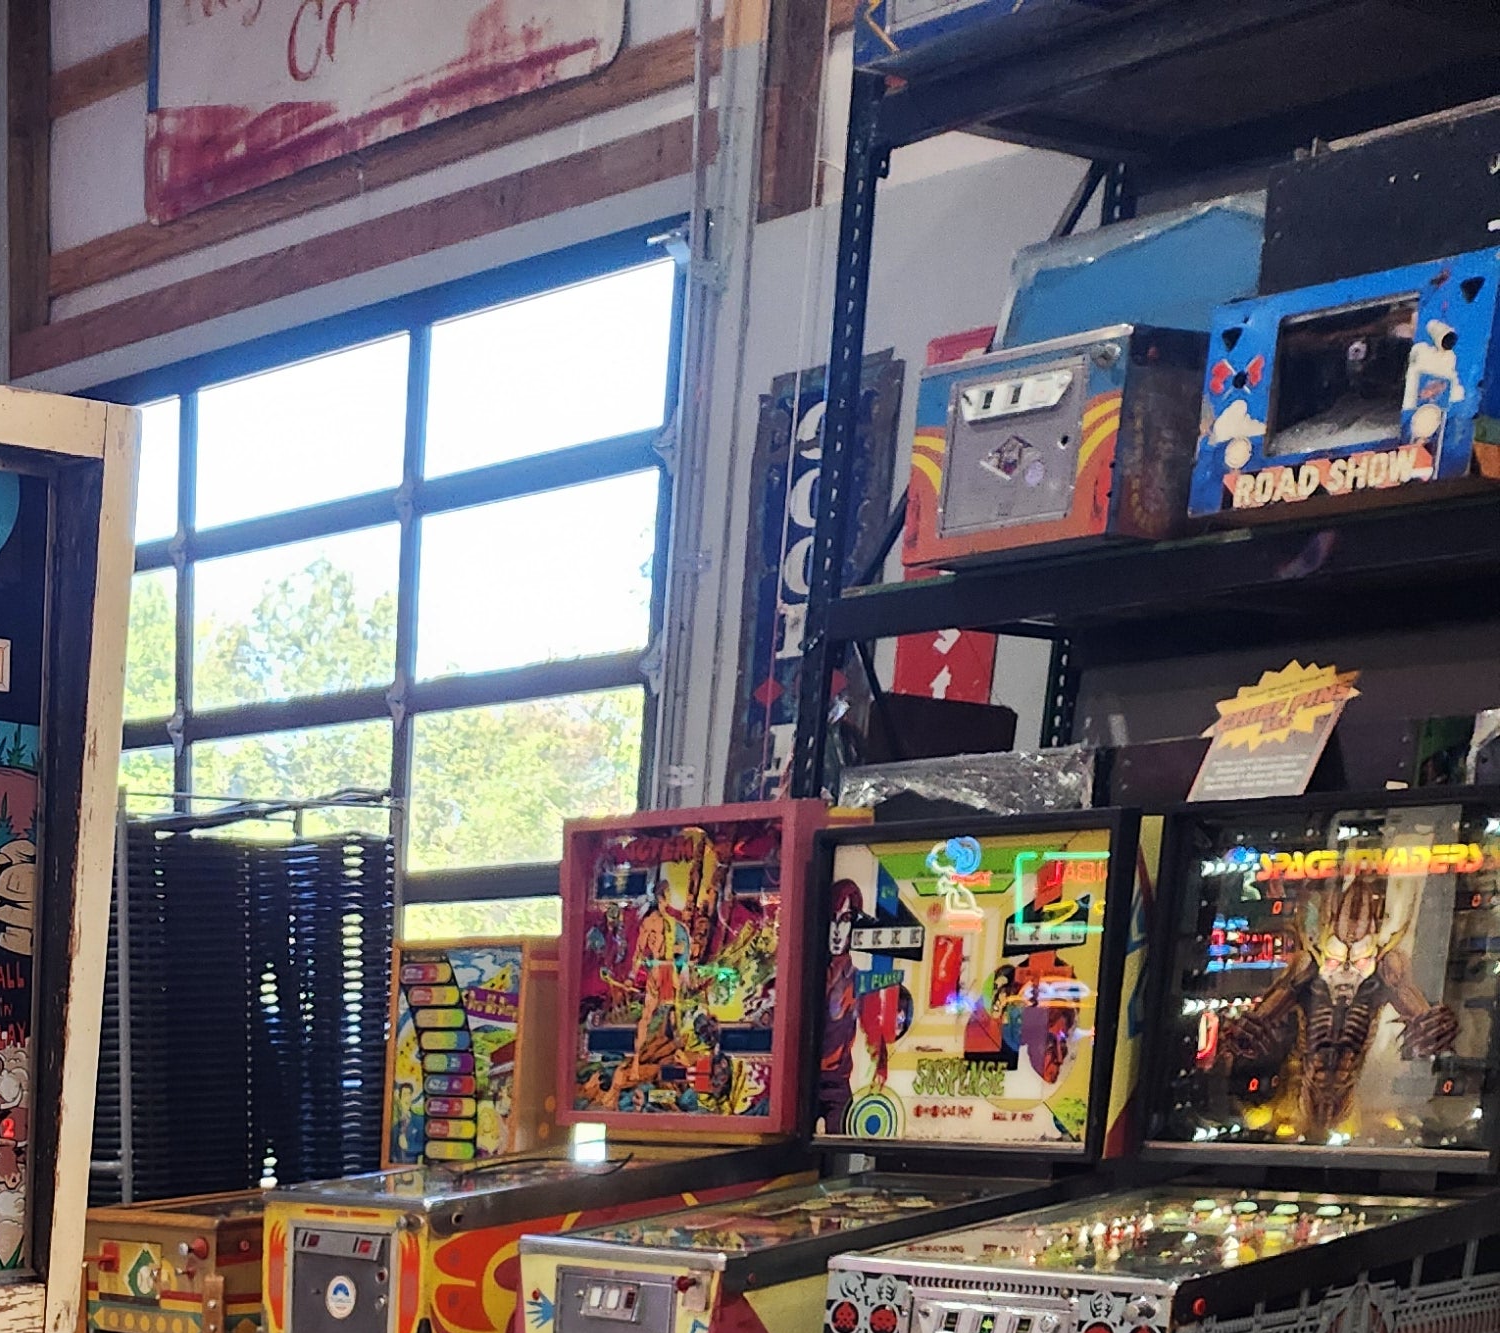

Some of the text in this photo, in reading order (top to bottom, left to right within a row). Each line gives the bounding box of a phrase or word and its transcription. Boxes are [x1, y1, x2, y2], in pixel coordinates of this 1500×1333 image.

[1232, 448, 1416, 508] ROAD SHOW
[1256, 850, 1340, 882] SPACE
[912, 1056, 1008, 1098] SUSPENSE
